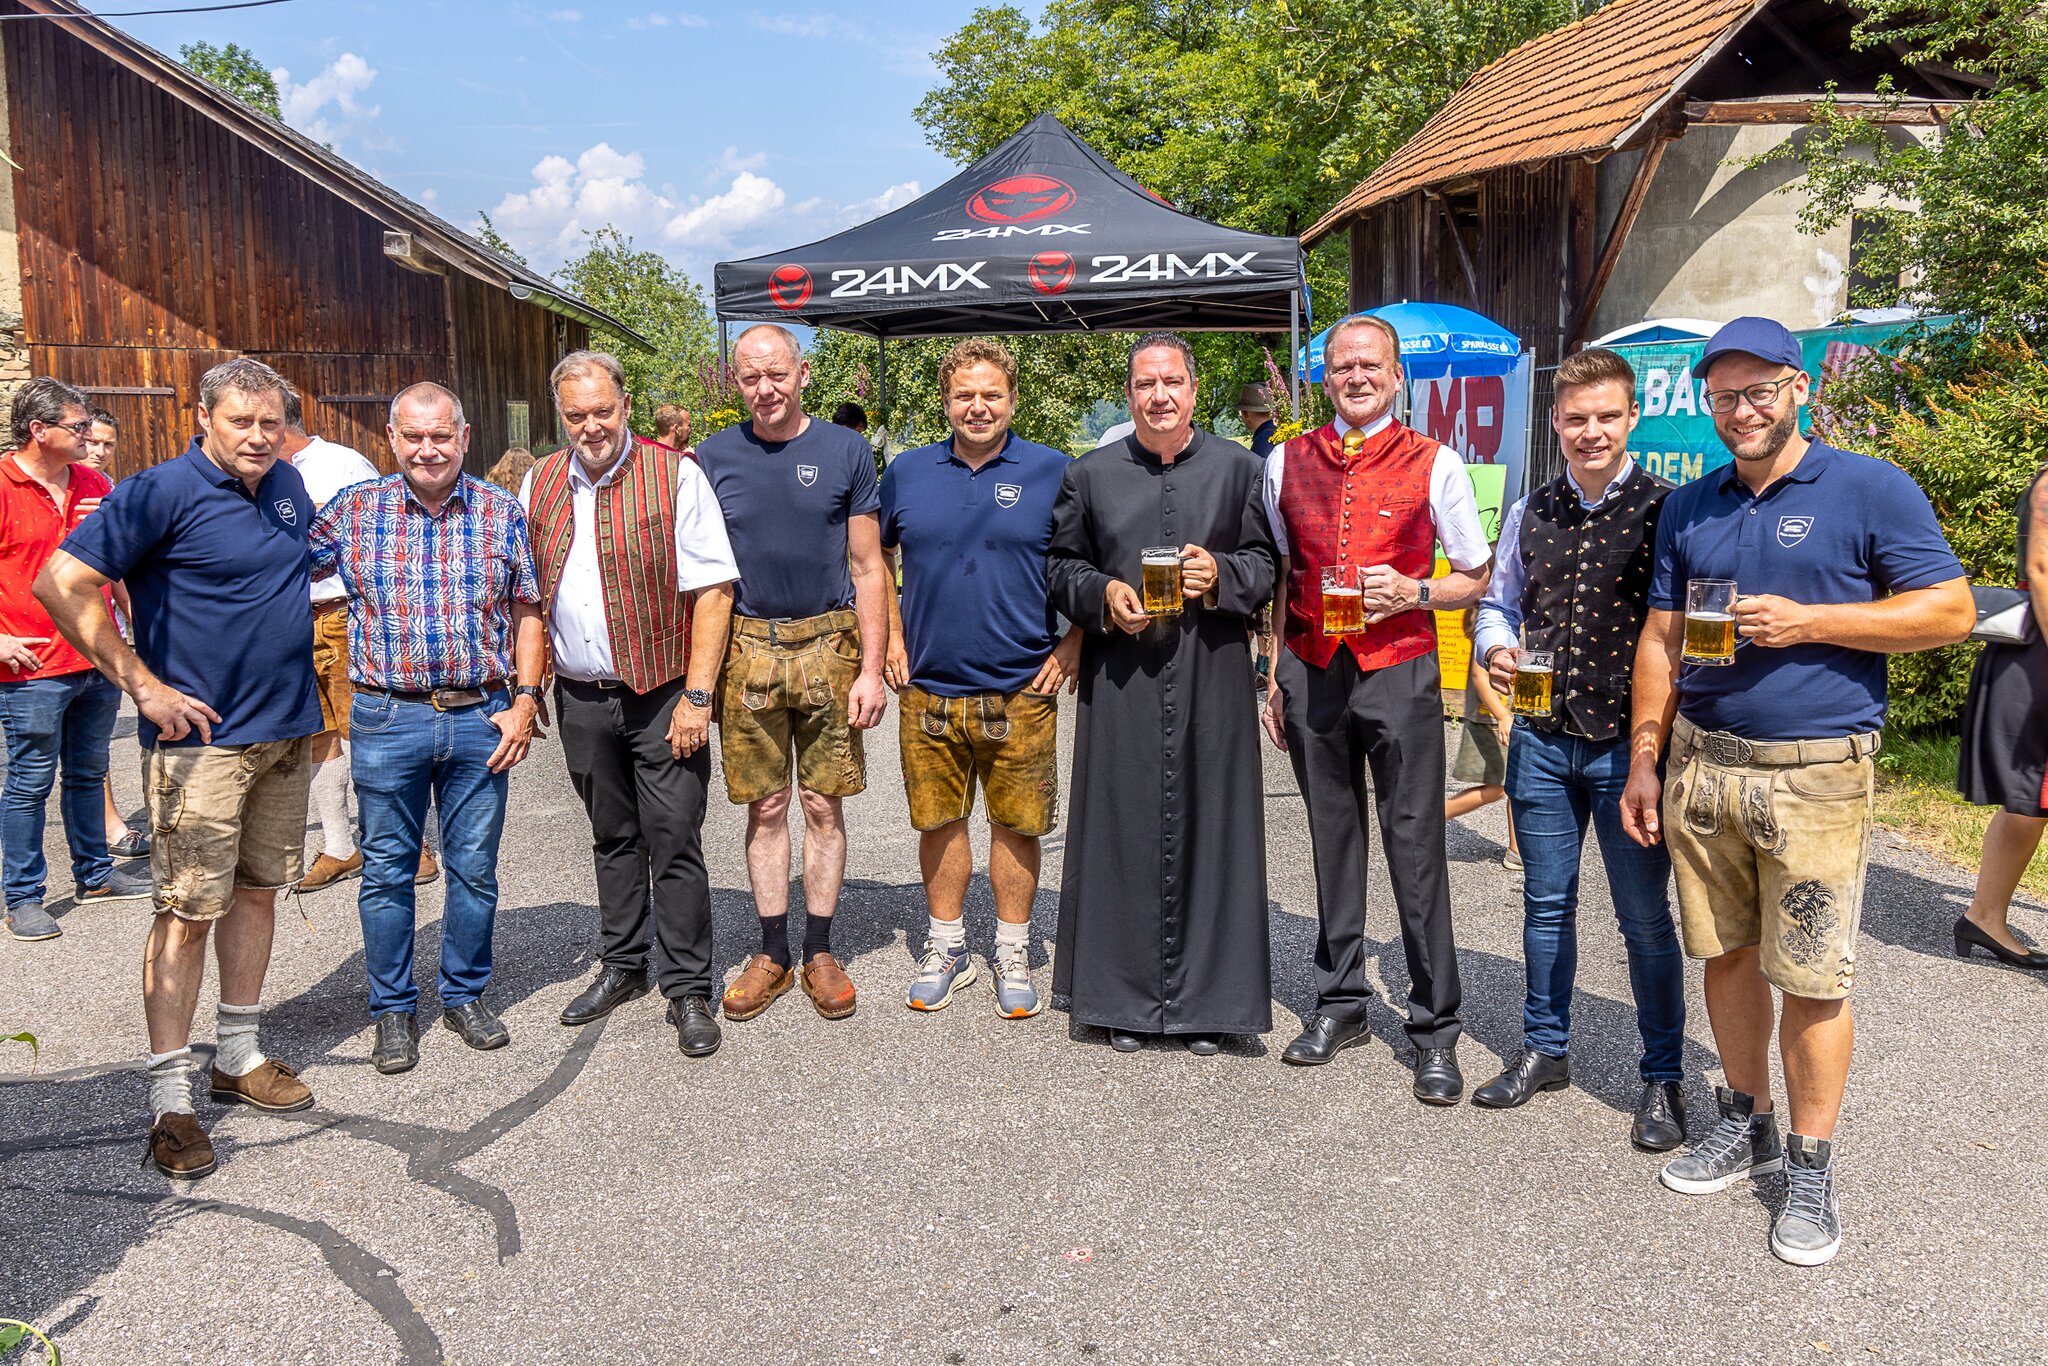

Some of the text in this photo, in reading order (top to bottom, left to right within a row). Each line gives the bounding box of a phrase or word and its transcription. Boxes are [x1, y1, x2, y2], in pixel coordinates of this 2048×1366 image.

[932, 223, 1092, 242] 24MX
[831, 261, 991, 298] 24MX
[1089, 251, 1261, 284] 24MX
[1461, 340, 1500, 352] SPARKASSE
[1645, 451, 1704, 487] DEM
